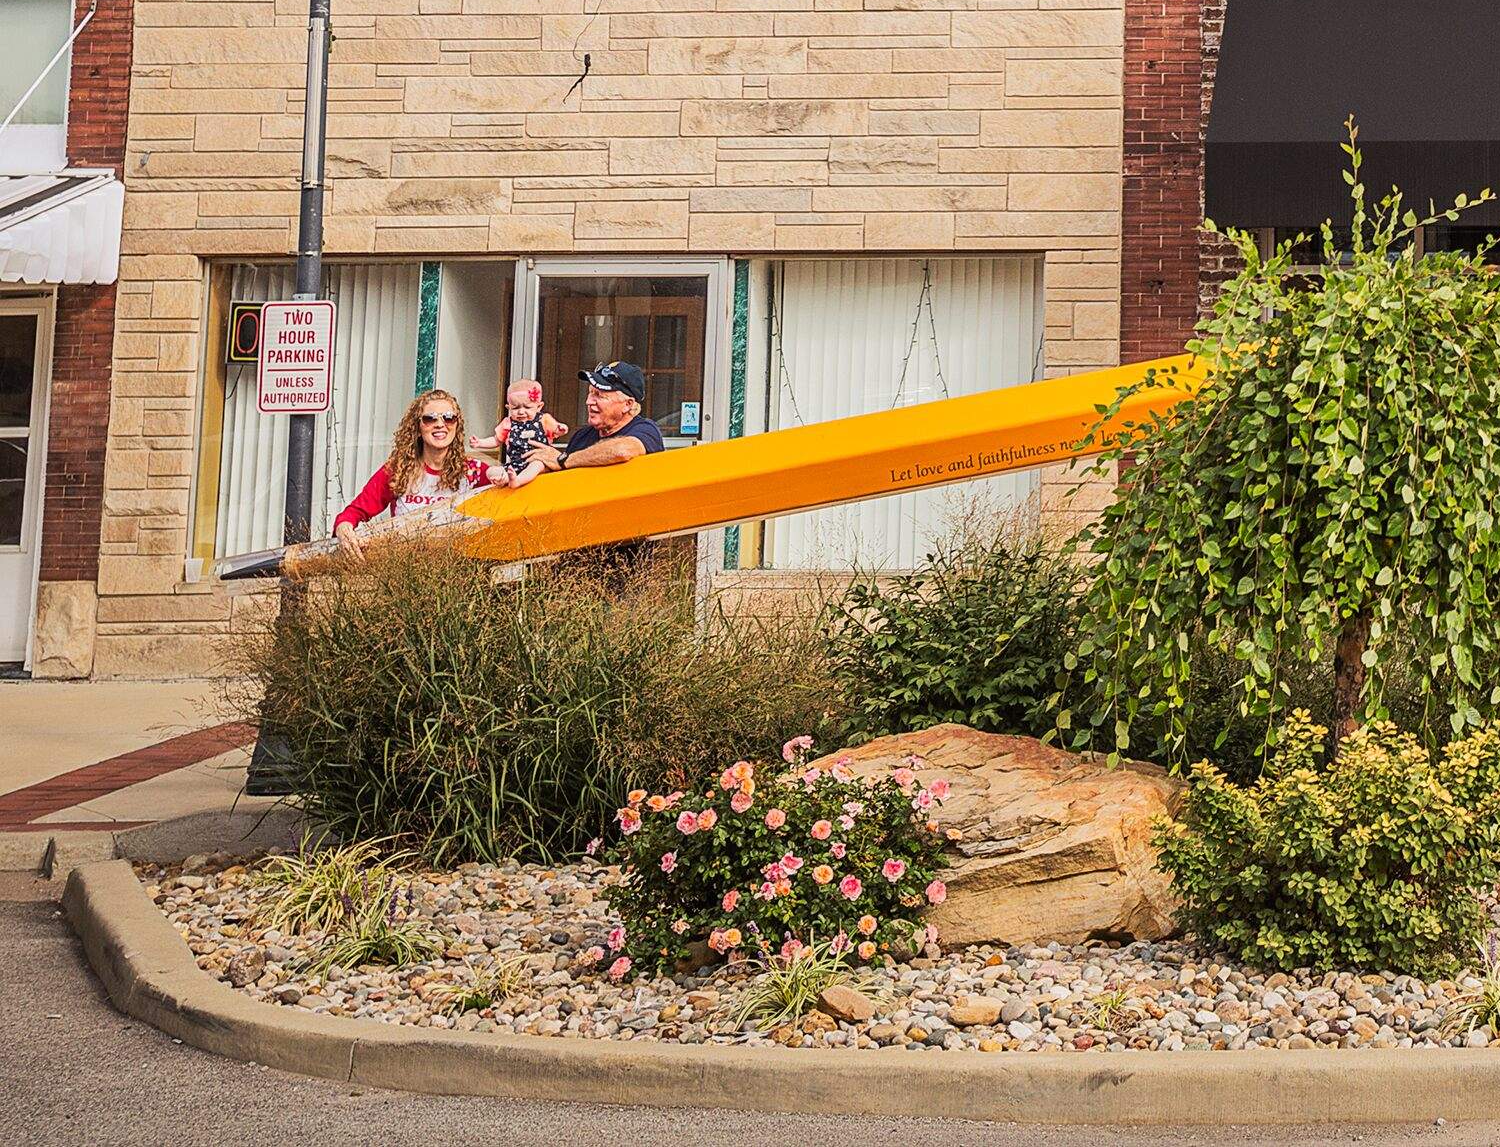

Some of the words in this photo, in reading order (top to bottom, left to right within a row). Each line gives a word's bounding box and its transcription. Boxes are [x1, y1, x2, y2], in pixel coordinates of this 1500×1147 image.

[284, 311, 313, 325] TWO
[278, 331, 315, 344] HOUR
[268, 349, 325, 363] PARKING
[275, 377, 314, 388] UNLESS
[263, 392, 325, 404] AUTHORIZED
[889, 469, 912, 483] Let
[915, 464, 944, 478] love
[948, 454, 974, 472] and
[976, 444, 1056, 470] faithfulness
